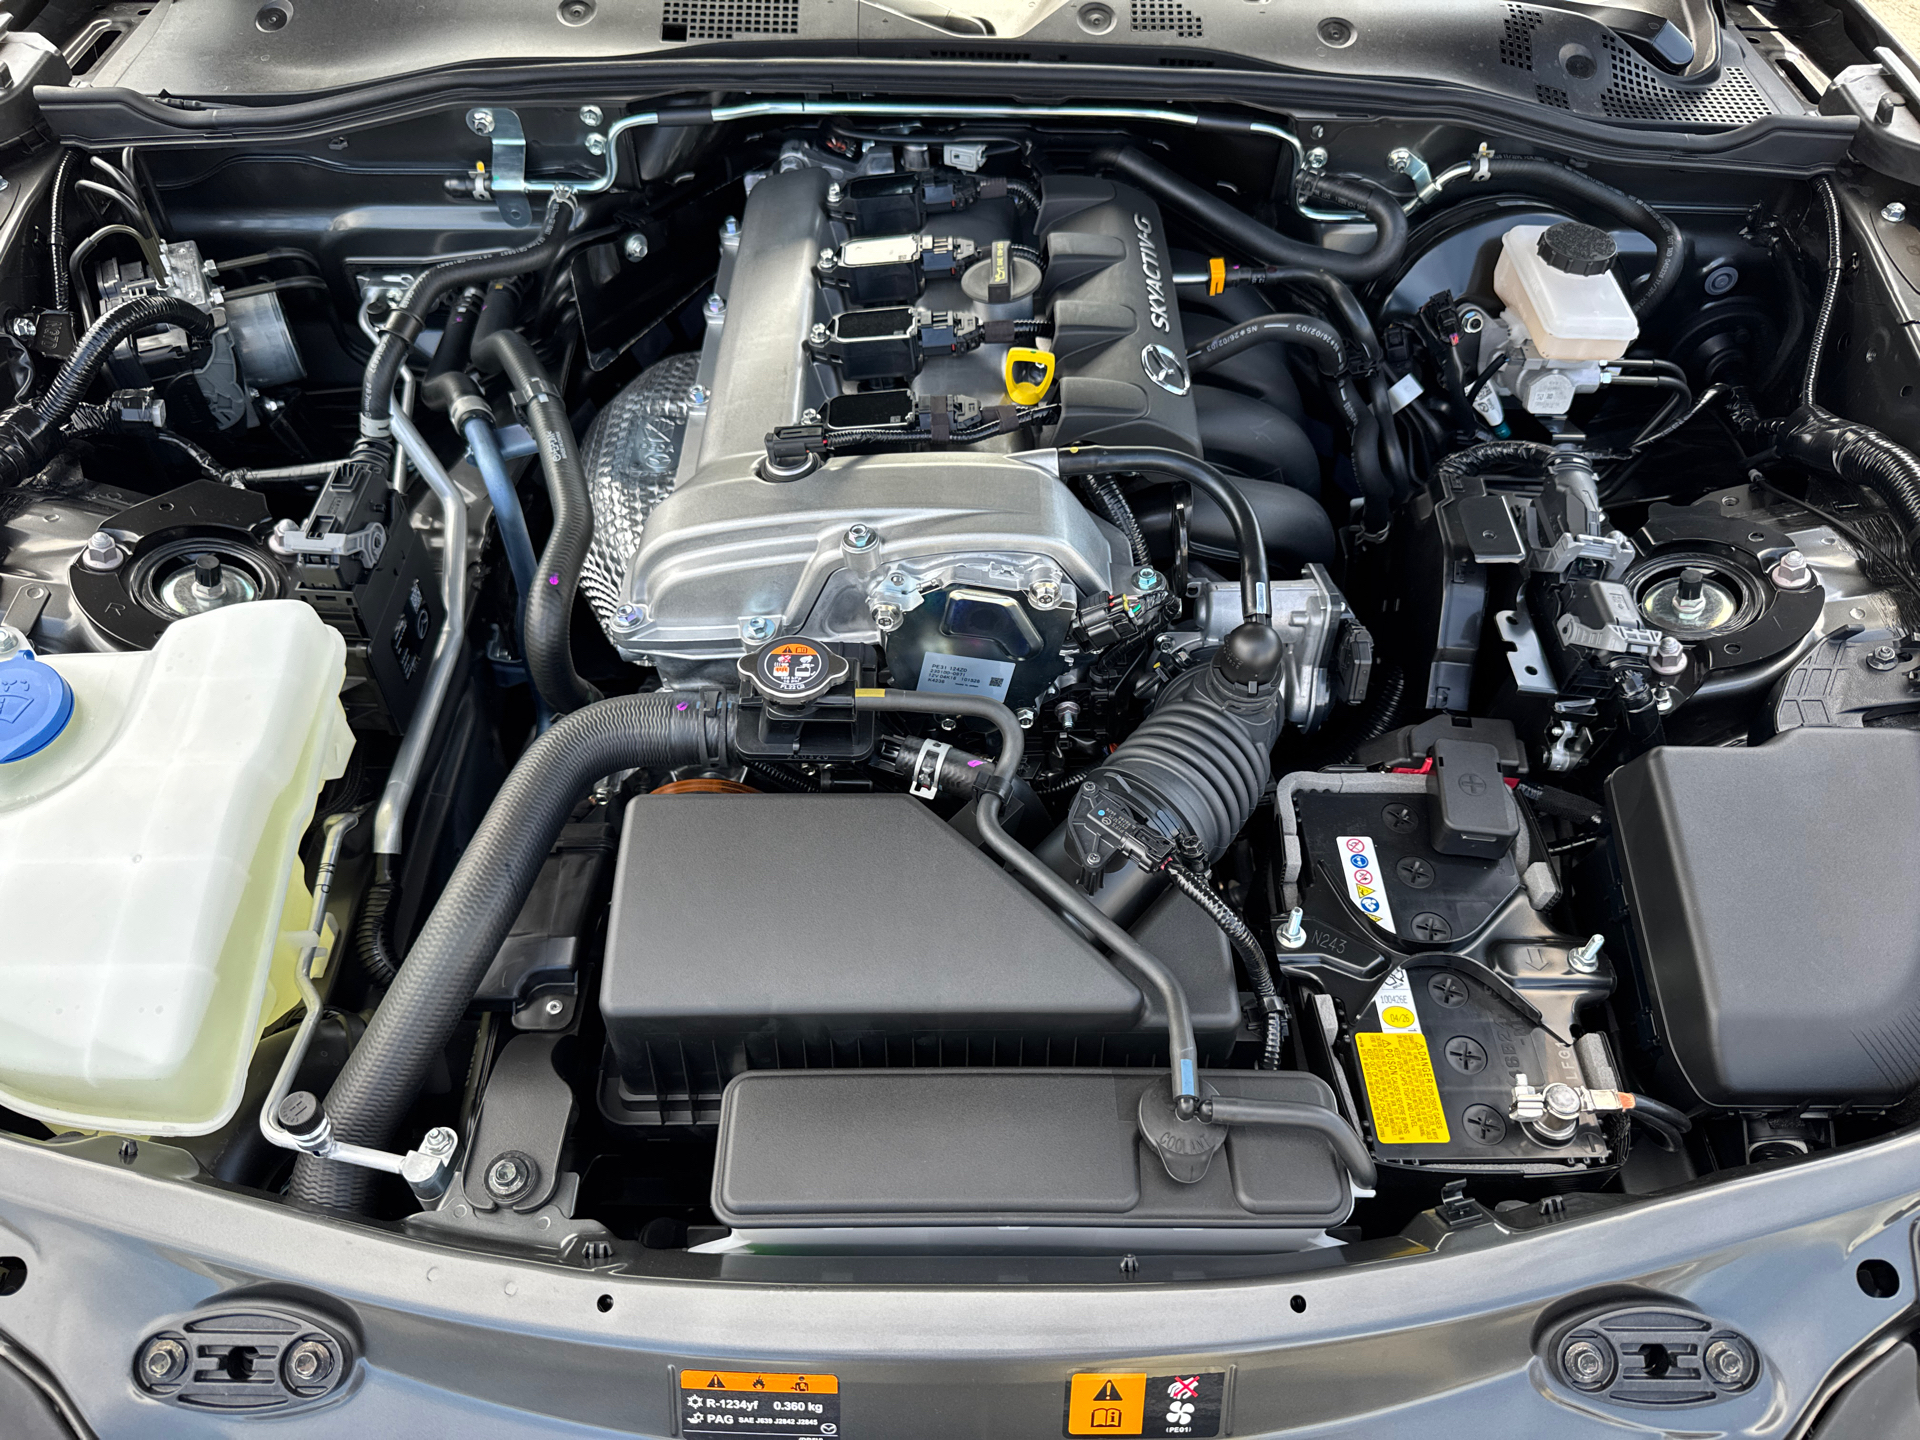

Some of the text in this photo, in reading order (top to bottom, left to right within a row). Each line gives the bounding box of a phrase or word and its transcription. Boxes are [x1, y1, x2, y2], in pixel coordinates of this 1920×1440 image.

[1133, 212, 1170, 333] SKYACTIV-G
[1310, 930, 1348, 953] N243
[1389, 1013, 1410, 1022] 04/26
[1384, 1048, 1398, 1075] POISON
[1558, 1041, 1578, 1081] LFG1
[1390, 1076, 1401, 1095] CAUSES
[1417, 1051, 1443, 1129] DANGER EXPLOSIVE GASES
[1395, 1096, 1406, 1116] SEVERE
[1160, 1131, 1212, 1154] COOLANT
[706, 1398, 823, 1413] R-1234yf 0.360 kg
[706, 1414, 734, 1424] PAG
